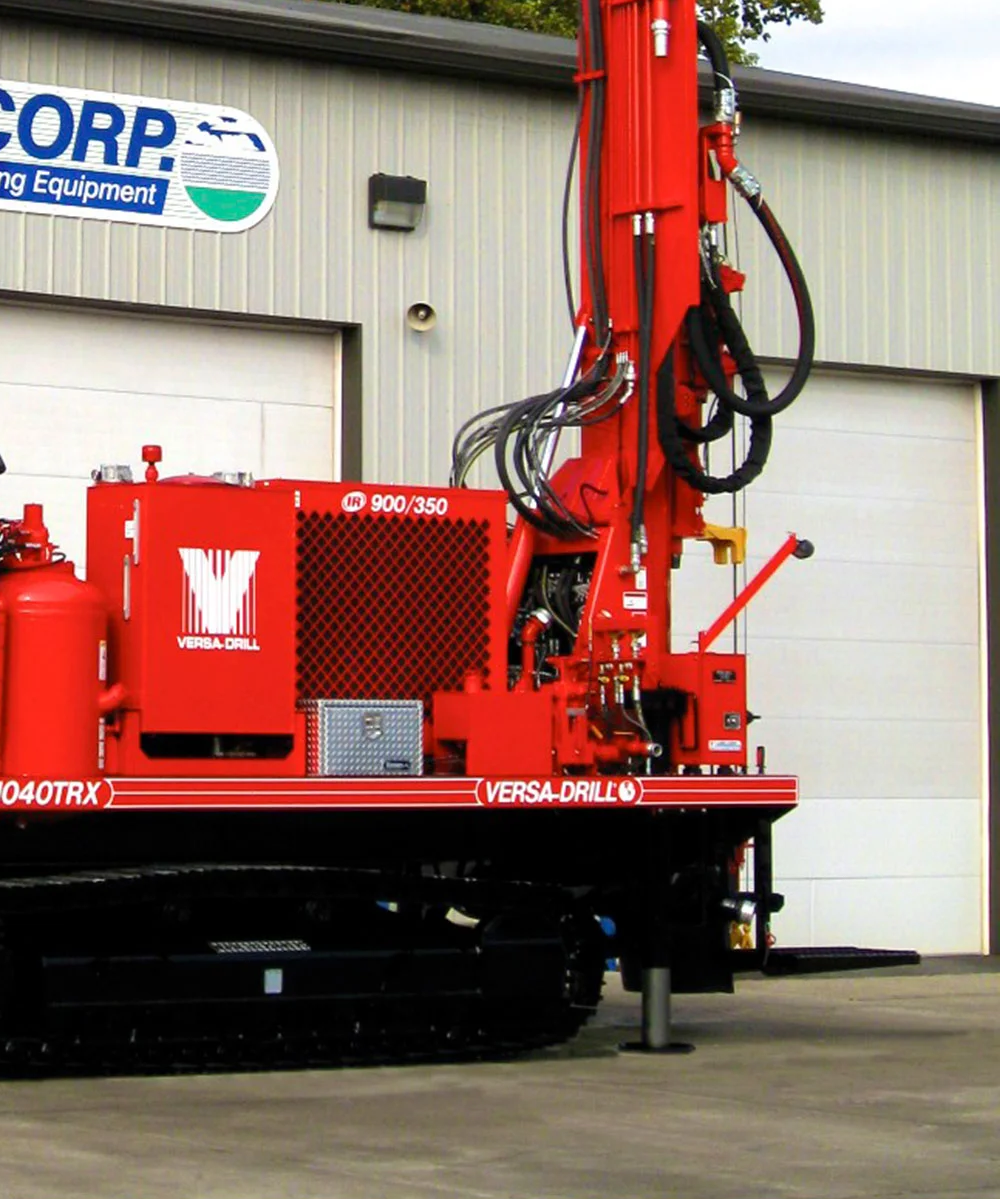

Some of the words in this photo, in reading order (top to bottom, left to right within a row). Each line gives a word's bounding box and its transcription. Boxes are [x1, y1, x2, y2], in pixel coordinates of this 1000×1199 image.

[33, 170, 157, 205] Equipment
[371, 494, 448, 515] 900/350
[177, 636, 260, 651] VERSA-DRILL
[486, 781, 620, 803] VERSA-DRILL
